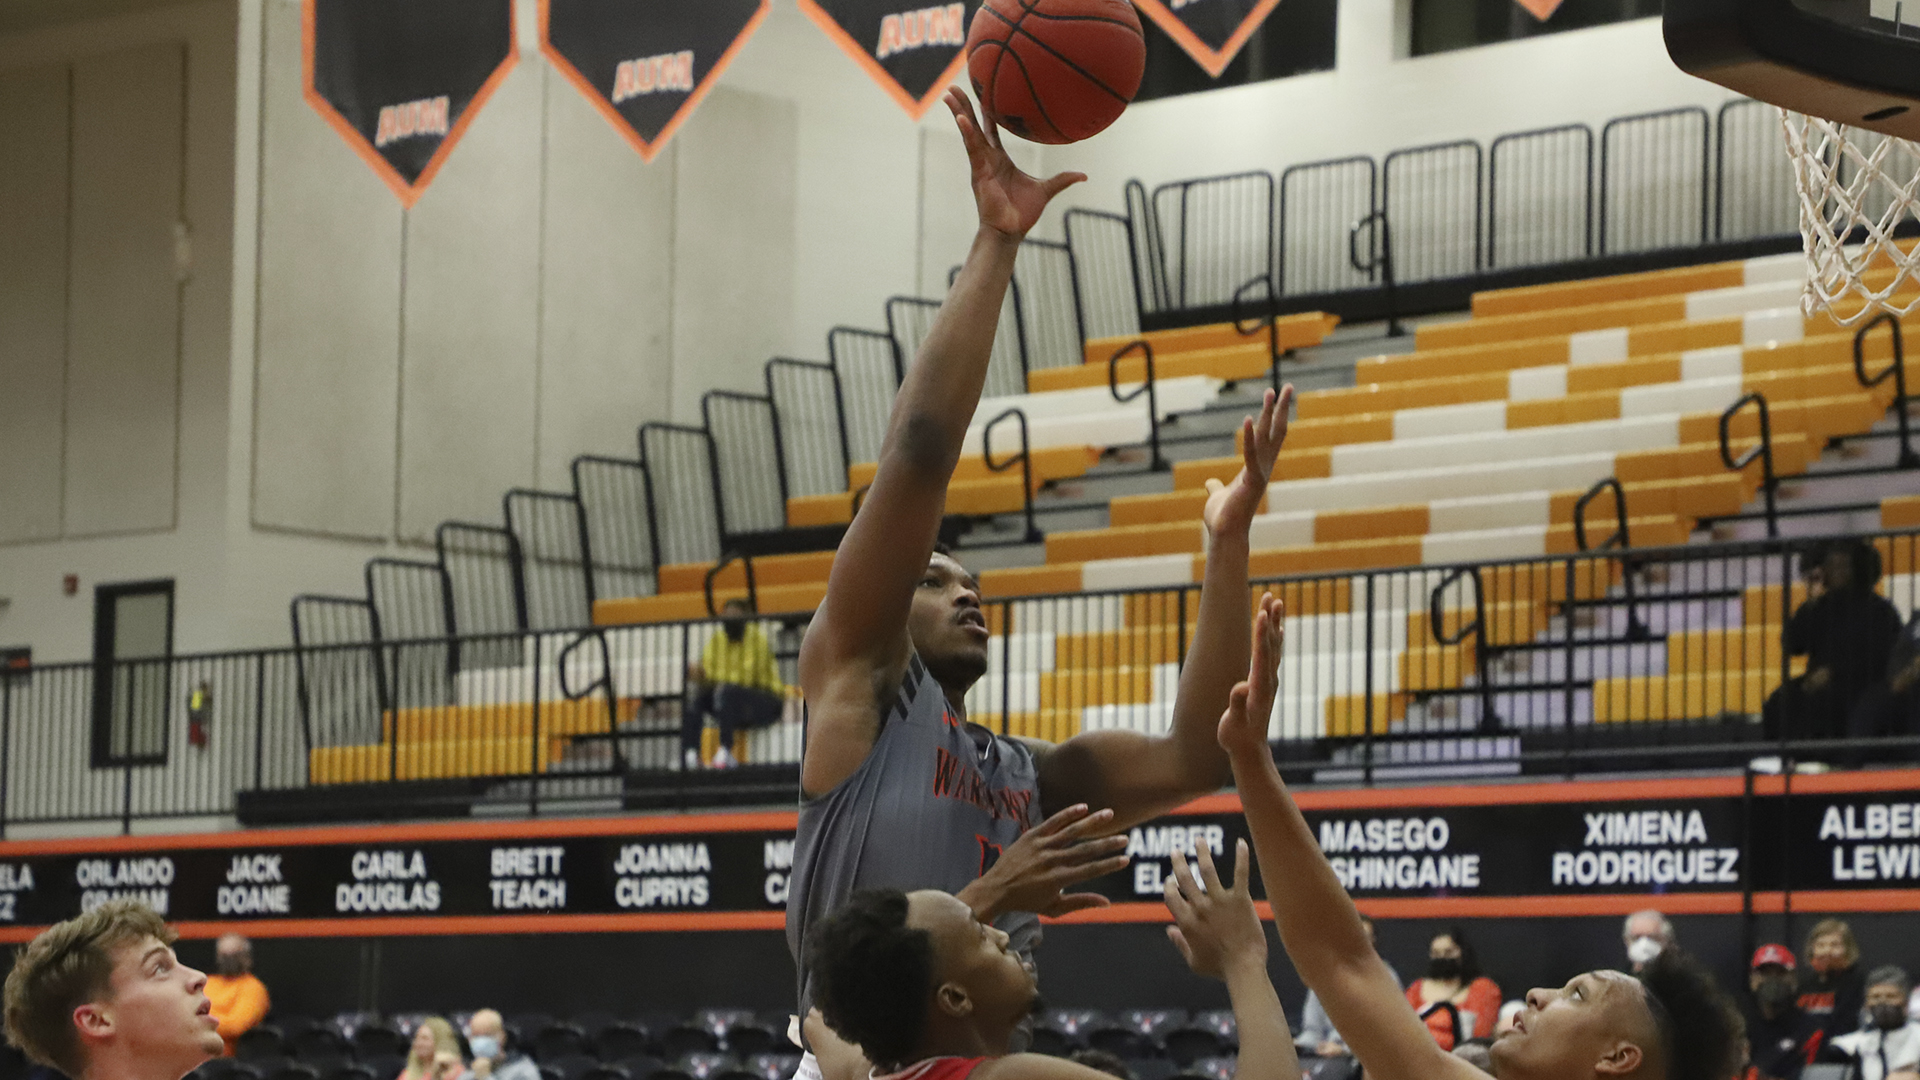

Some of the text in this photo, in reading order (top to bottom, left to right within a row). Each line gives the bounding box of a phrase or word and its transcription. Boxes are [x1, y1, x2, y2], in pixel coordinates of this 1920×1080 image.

[876, 2, 965, 59] AUM
[612, 50, 694, 103] AUM
[375, 95, 449, 147] AUM
[1126, 824, 1224, 857] AMBER
[1319, 817, 1450, 852] MASEGO
[1584, 810, 1708, 846] XIMENA
[76, 857, 175, 887] ORLANDO
[226, 854, 282, 883] JACK
[351, 851, 427, 880] CARLA
[490, 847, 565, 876] BRETT
[614, 843, 711, 875] JOANNA
[1552, 848, 1739, 886] RODRIGUEZ
[1832, 844, 1920, 881] LEWI
[217, 885, 291, 914] DOANE
[335, 881, 441, 912] DOUGLAS
[489, 879, 567, 909] TEACH
[614, 875, 710, 908] CUPRYS
